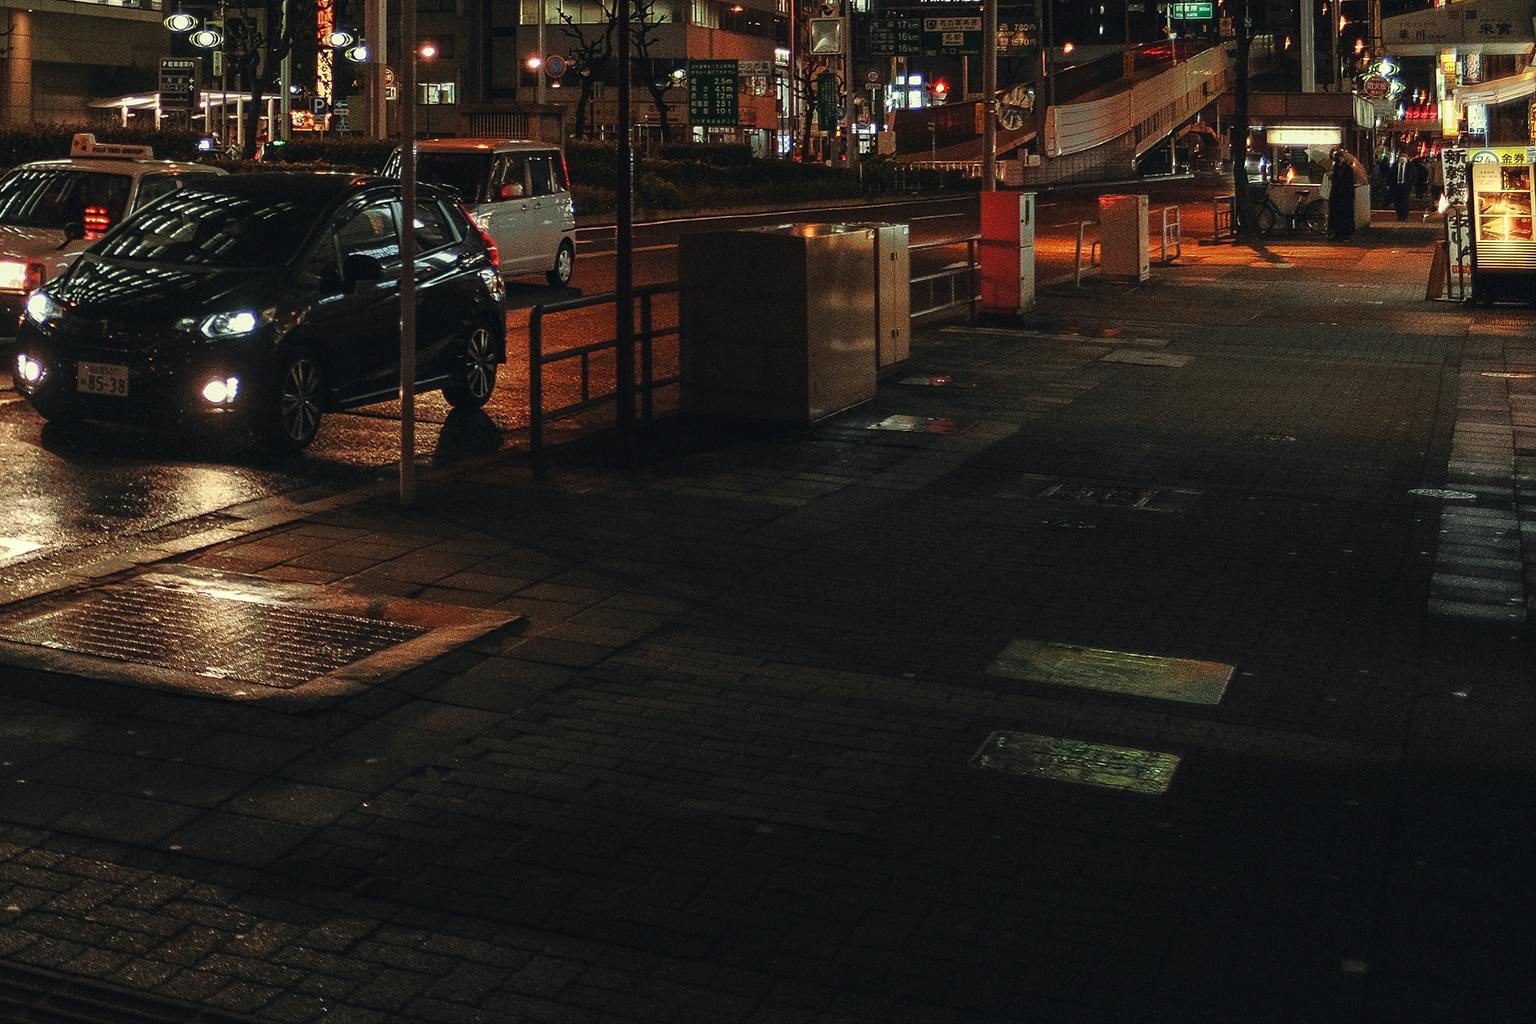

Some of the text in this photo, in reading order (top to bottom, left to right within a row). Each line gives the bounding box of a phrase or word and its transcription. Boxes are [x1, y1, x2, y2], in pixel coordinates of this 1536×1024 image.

[314, 98, 325, 113] P
[1501, 152, 1525, 164] 金券
[88, 374, 125, 394] 85-38
